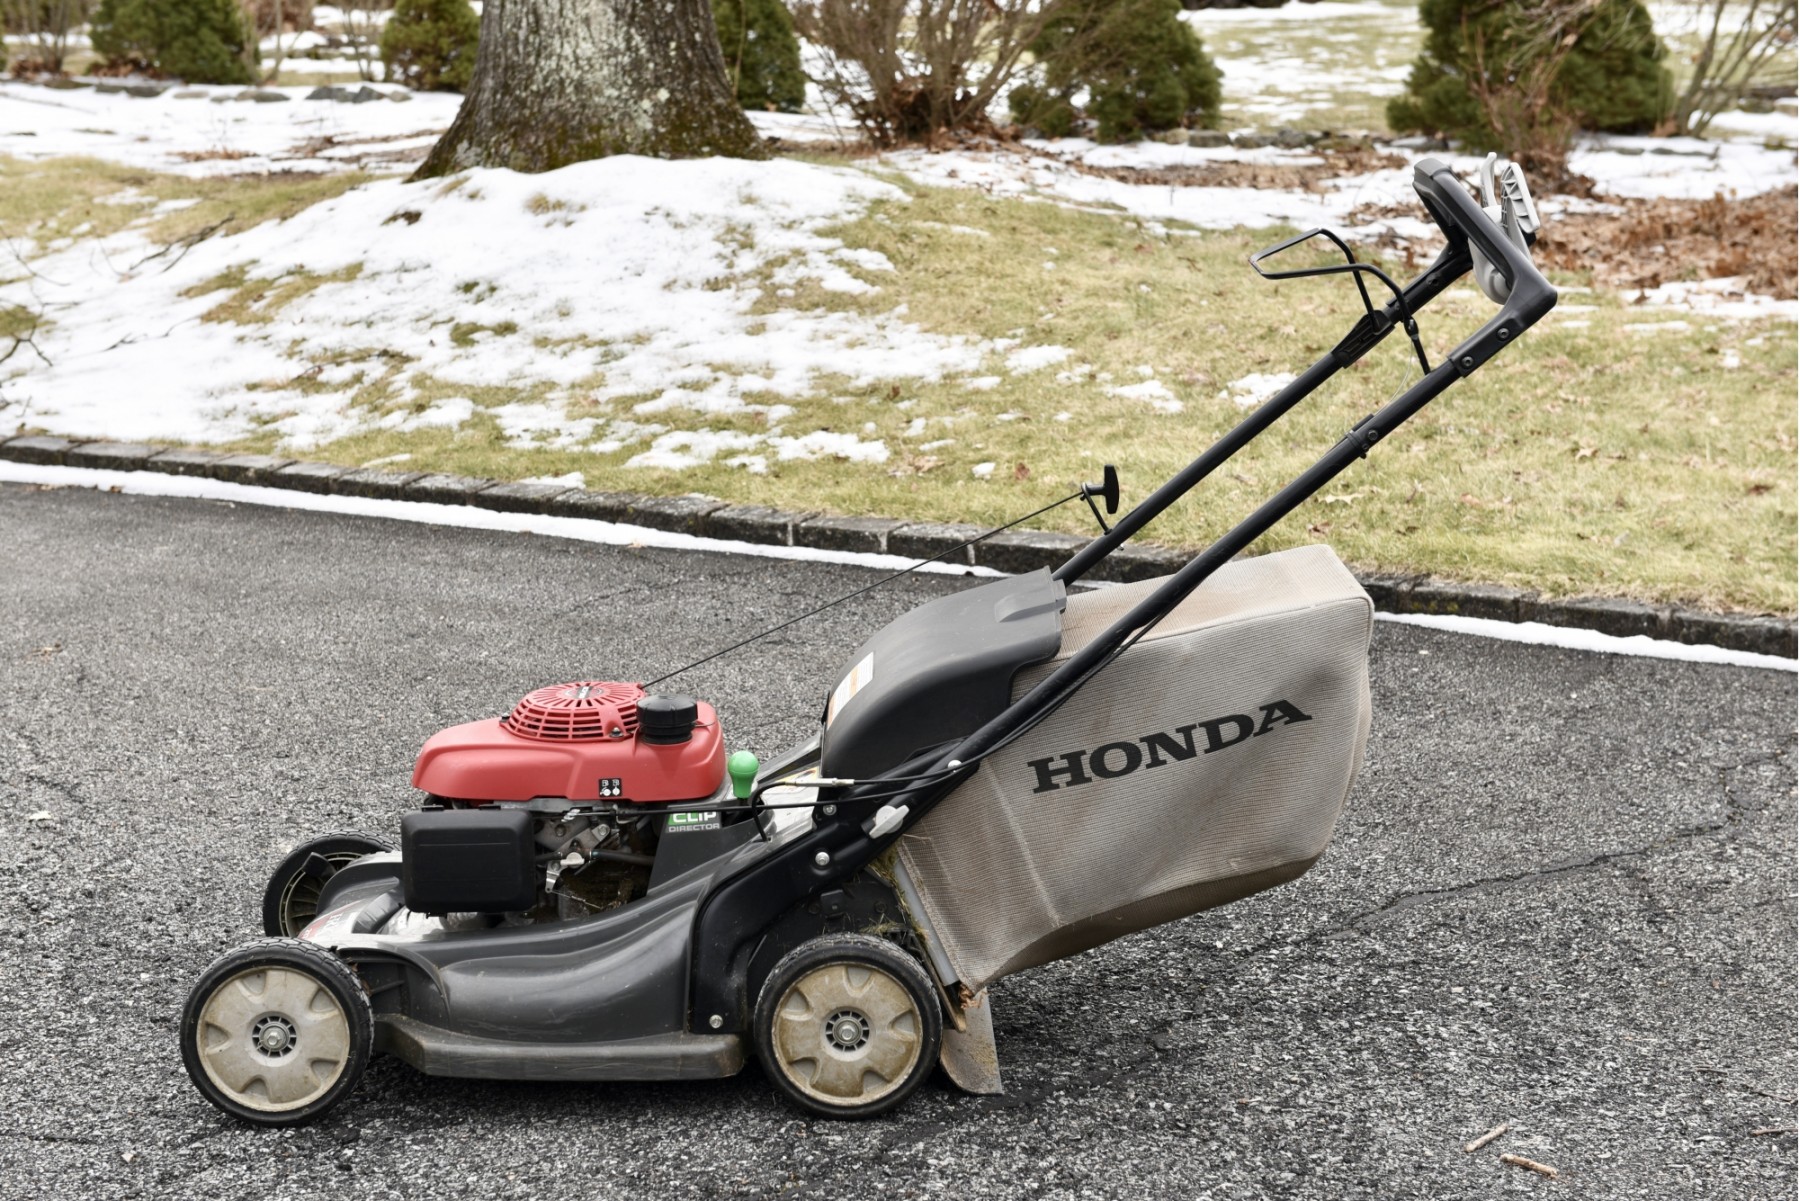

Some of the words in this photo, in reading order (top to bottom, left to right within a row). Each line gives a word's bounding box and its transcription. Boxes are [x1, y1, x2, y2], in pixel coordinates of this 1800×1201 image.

[1027, 699, 1312, 793] HONDA
[673, 811, 716, 822] CLIP
[668, 823, 720, 832] DIRECTOR
